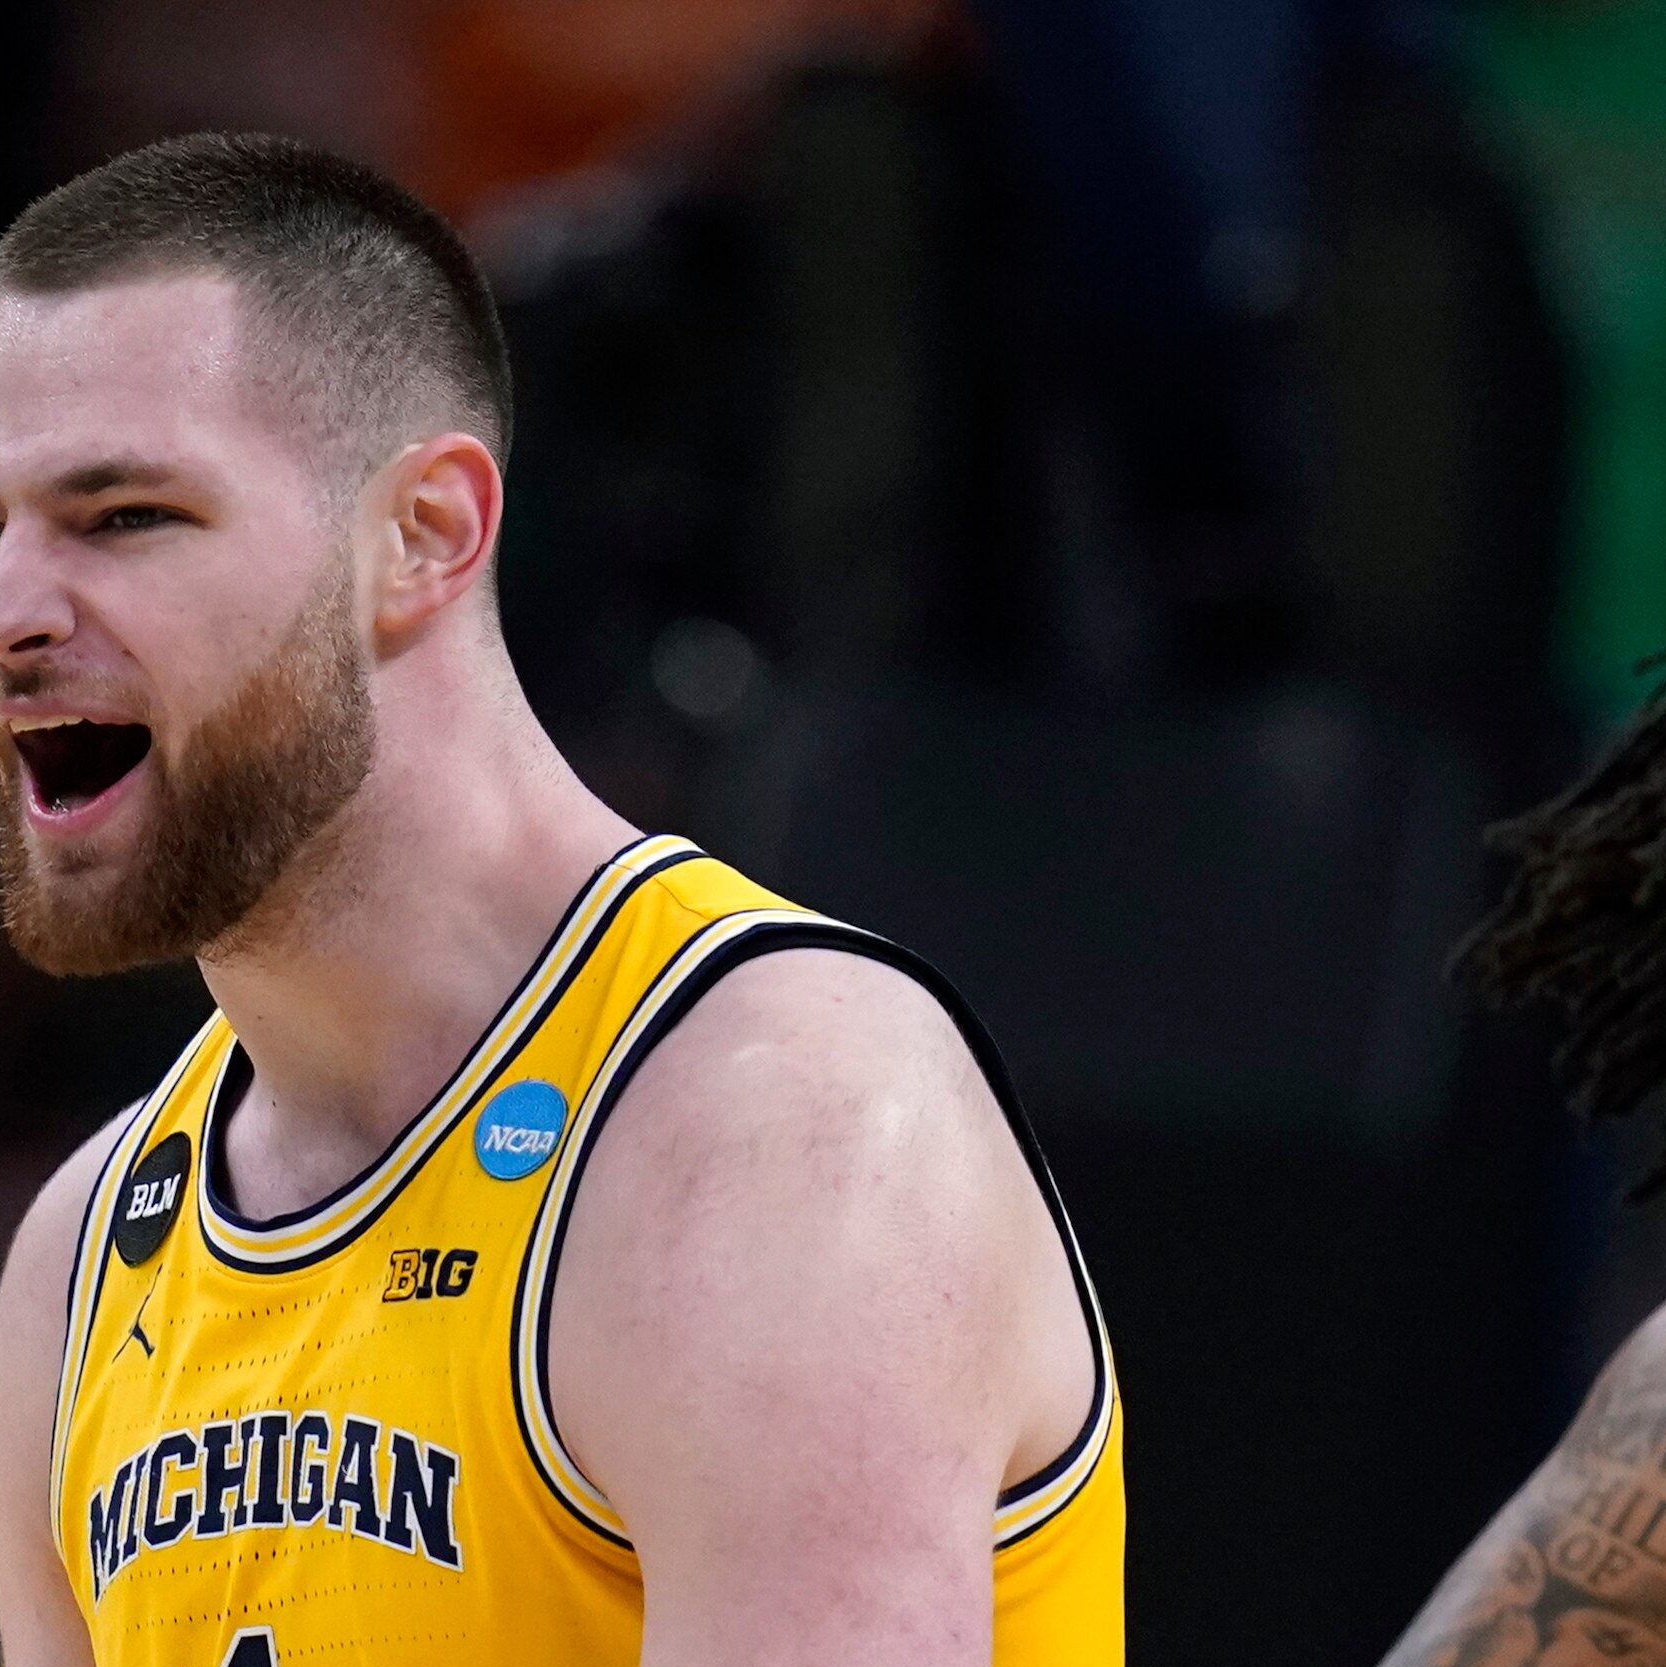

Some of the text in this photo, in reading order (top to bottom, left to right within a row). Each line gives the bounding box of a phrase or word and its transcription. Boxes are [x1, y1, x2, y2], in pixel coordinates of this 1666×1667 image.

[483, 1124, 557, 1154] NCAA
[126, 1172, 181, 1221] BLM
[89, 1409, 464, 1609] MICHIGAN
